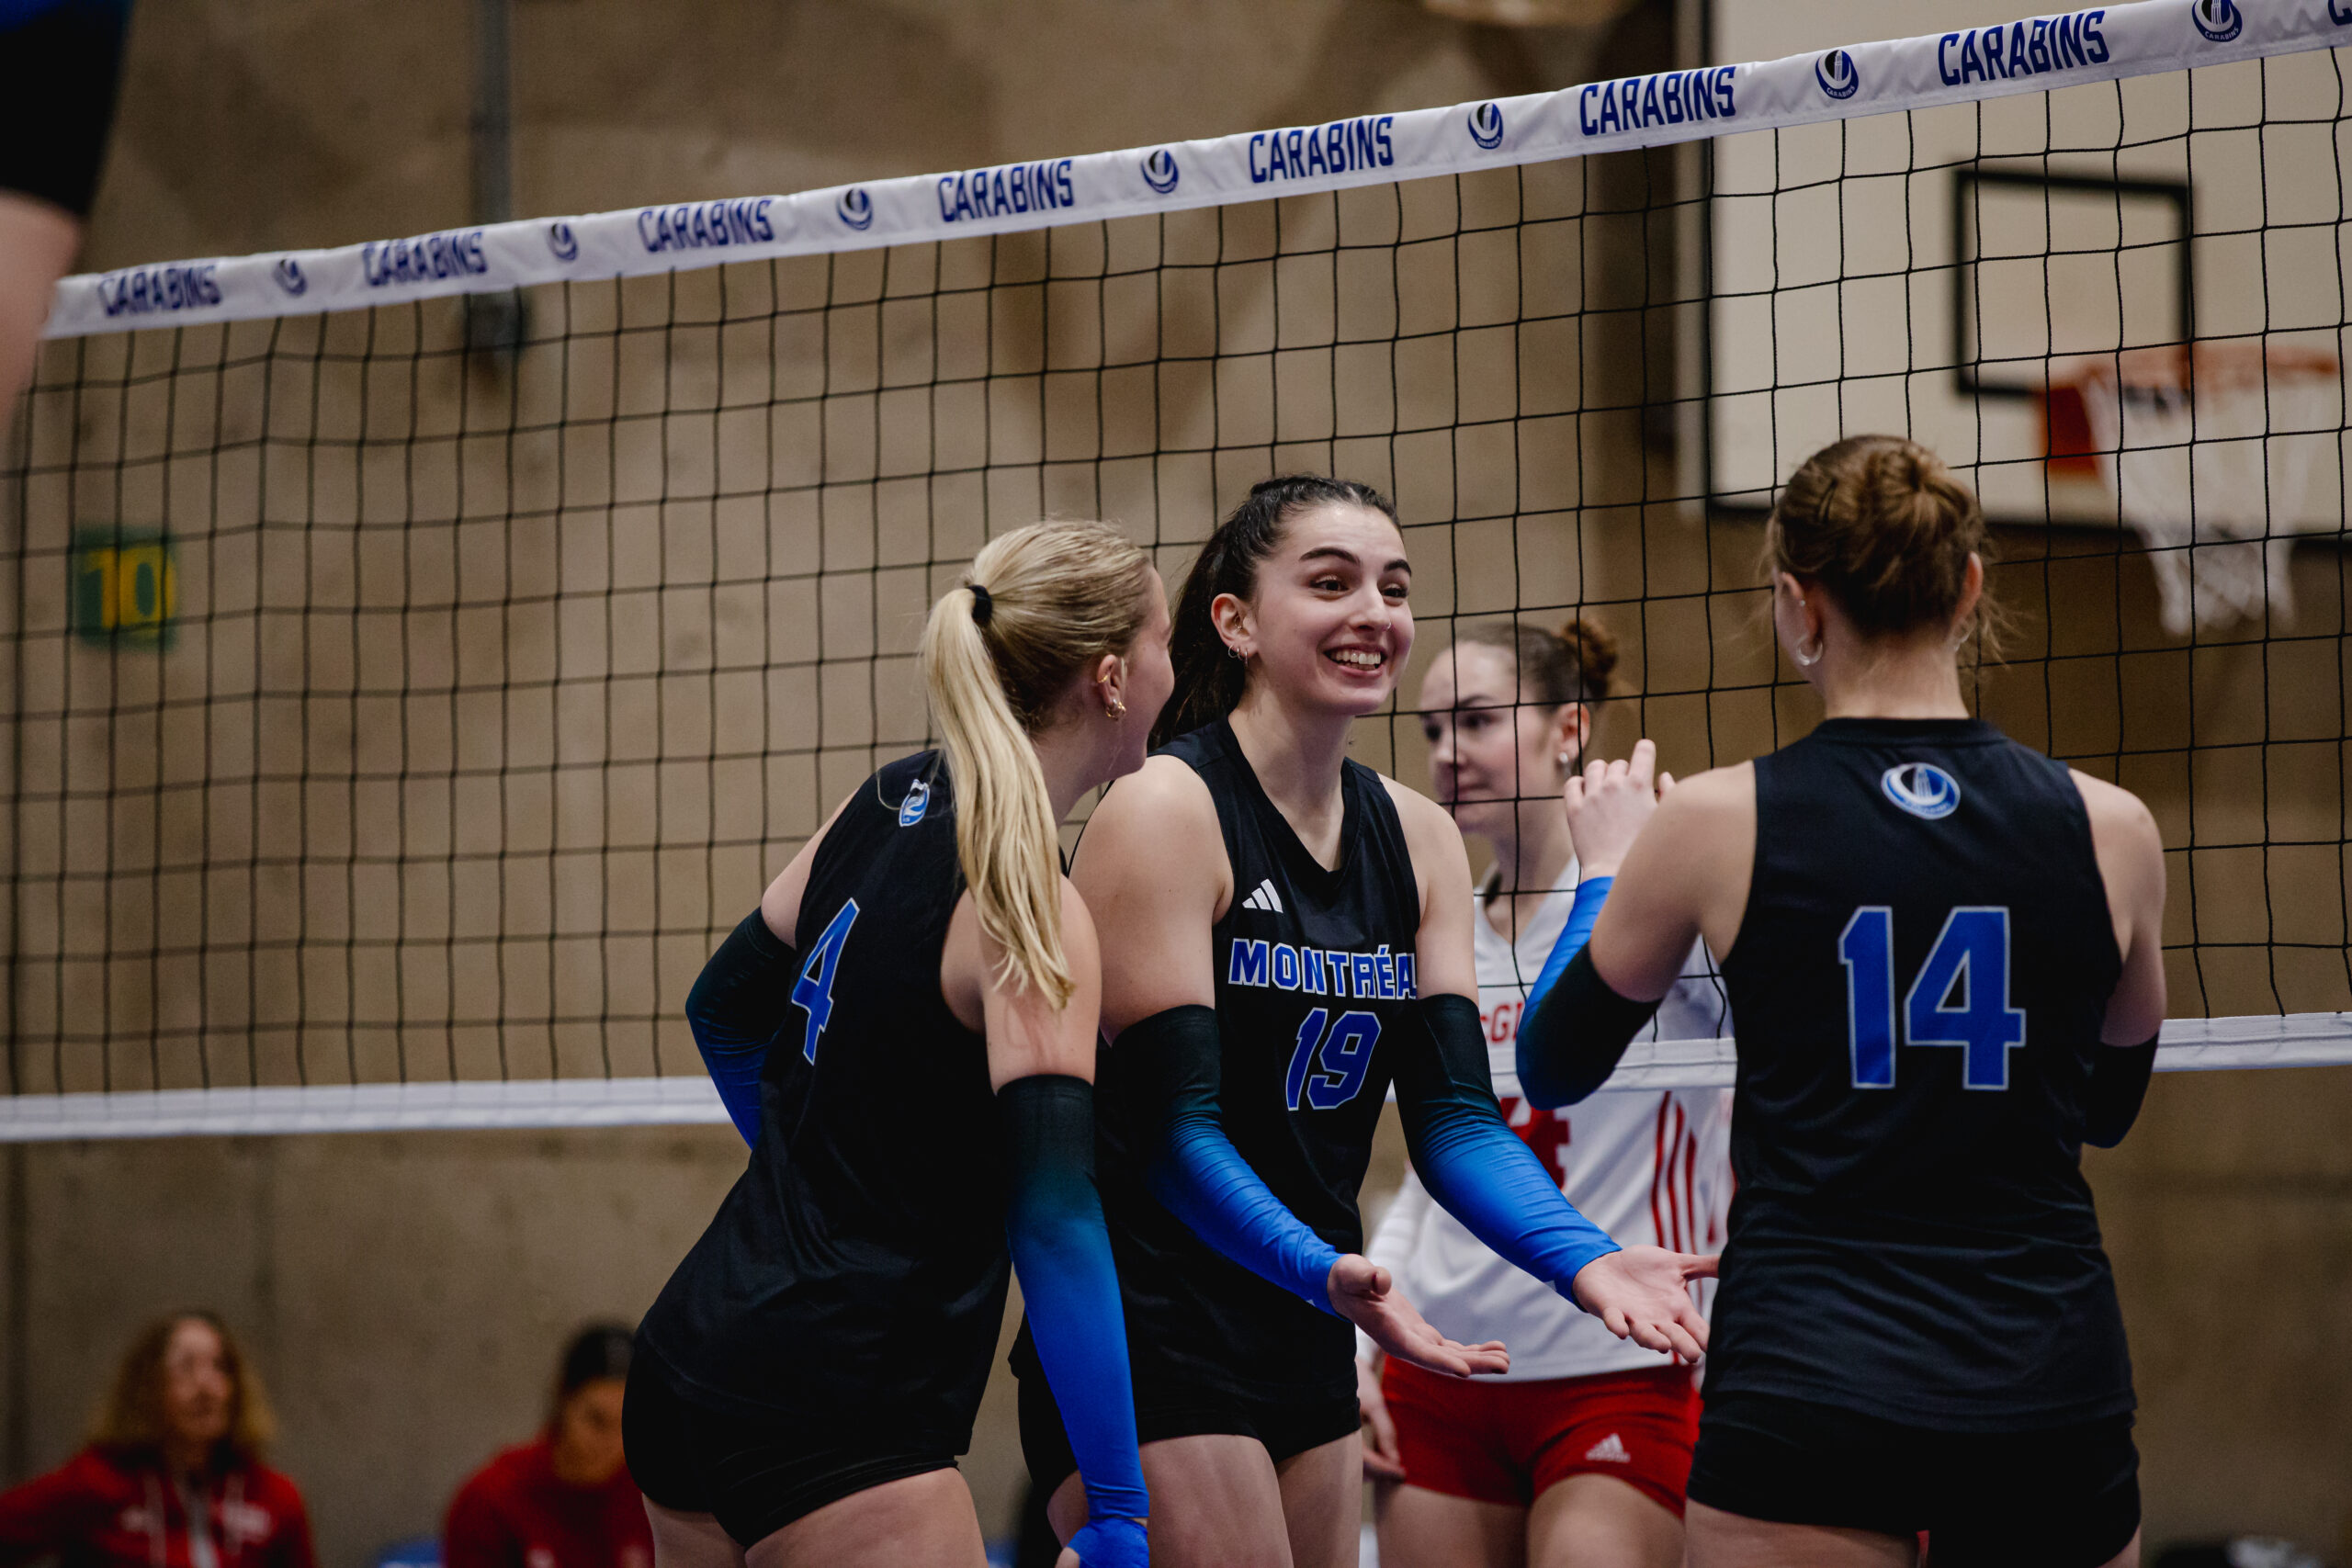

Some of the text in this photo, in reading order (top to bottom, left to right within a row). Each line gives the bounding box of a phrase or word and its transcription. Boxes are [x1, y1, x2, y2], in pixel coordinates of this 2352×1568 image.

[98, 10, 2110, 317] CARABINS CARABINS CARABINS CARABINS CARABINS CARABINS CARABINS
[82, 546, 176, 636] 10
[791, 897, 860, 1066] 4
[1286, 1007, 1382, 1111] 19
[1838, 906, 2026, 1090] 14
